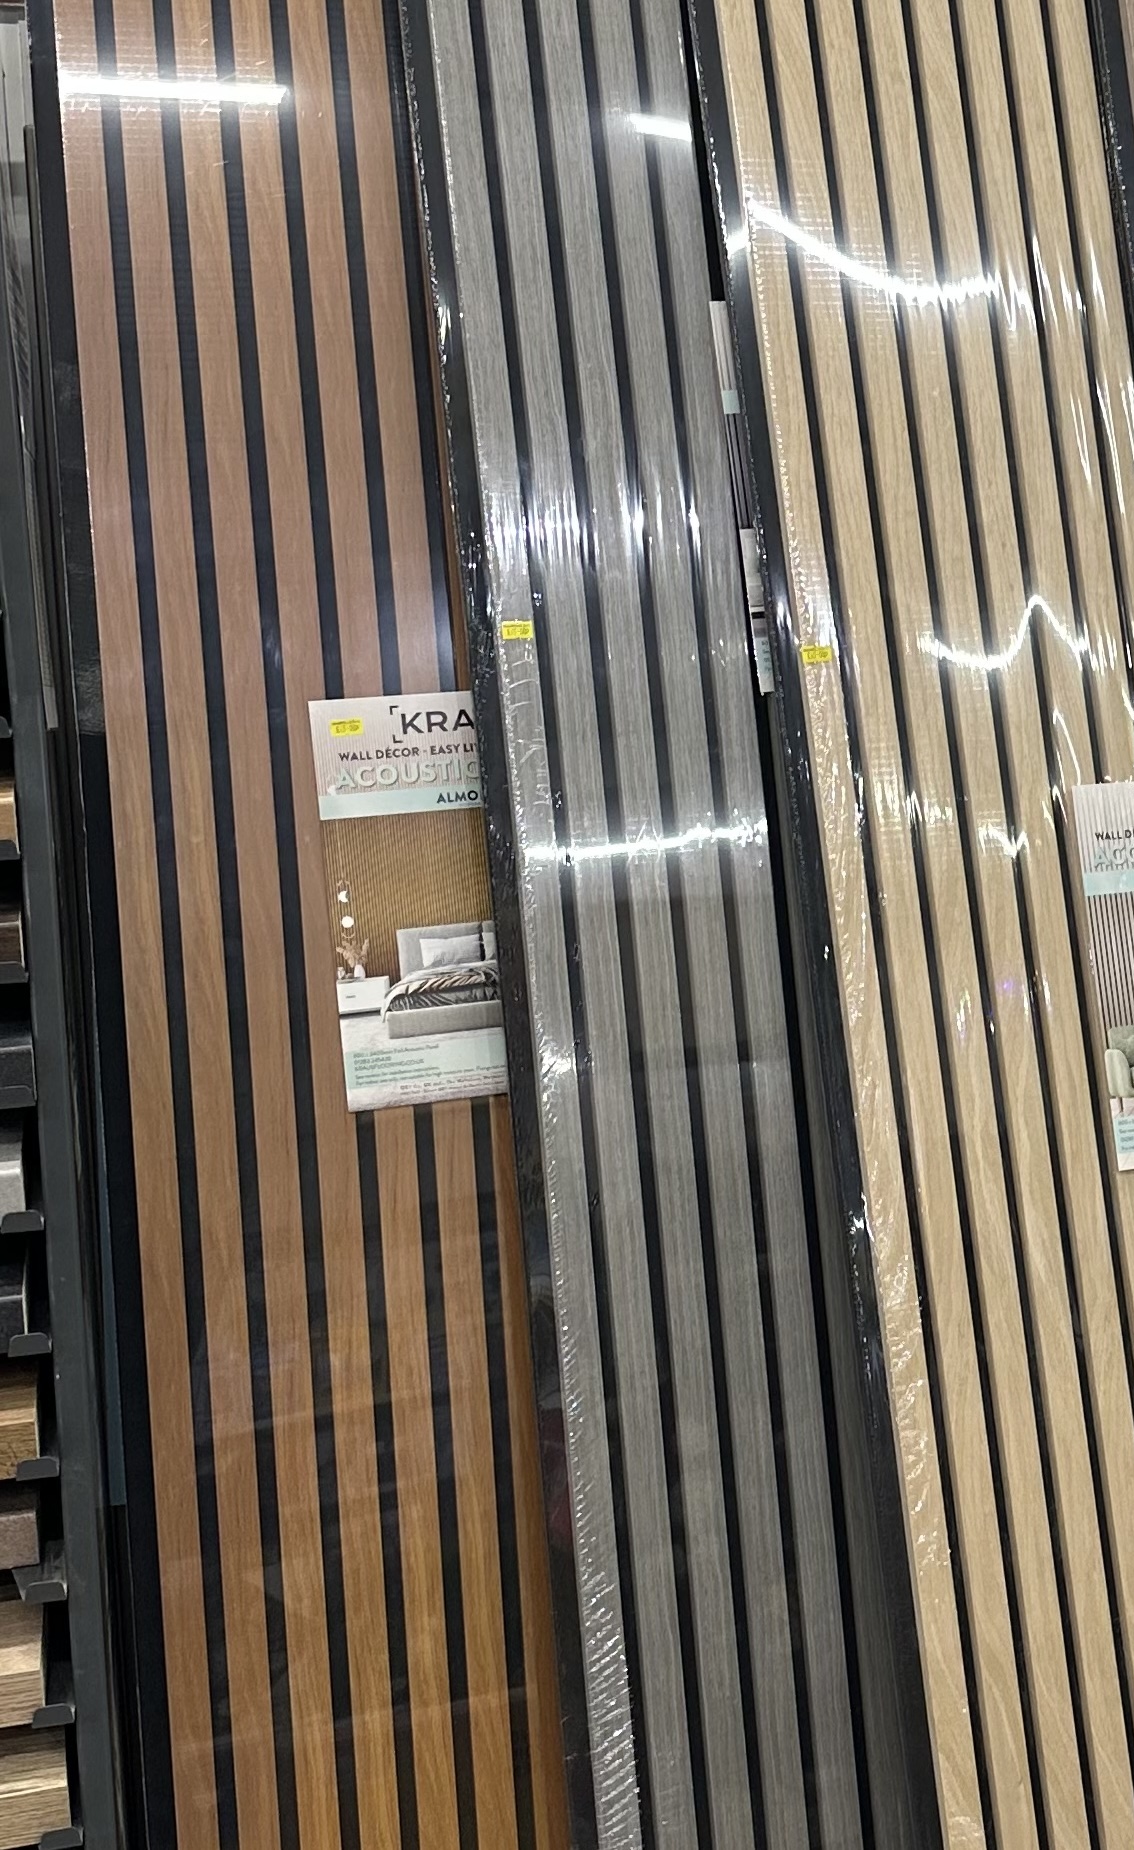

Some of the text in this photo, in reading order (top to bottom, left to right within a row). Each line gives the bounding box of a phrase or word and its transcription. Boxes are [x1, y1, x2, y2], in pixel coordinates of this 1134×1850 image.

[401, 709, 475, 735] KRA
[338, 752, 373, 762] WALL
[376, 746, 420, 760] DÉCOR
[431, 744, 461, 756] EASY
[436, 790, 479, 804] ALMO
[1095, 831, 1122, 841] WALL
